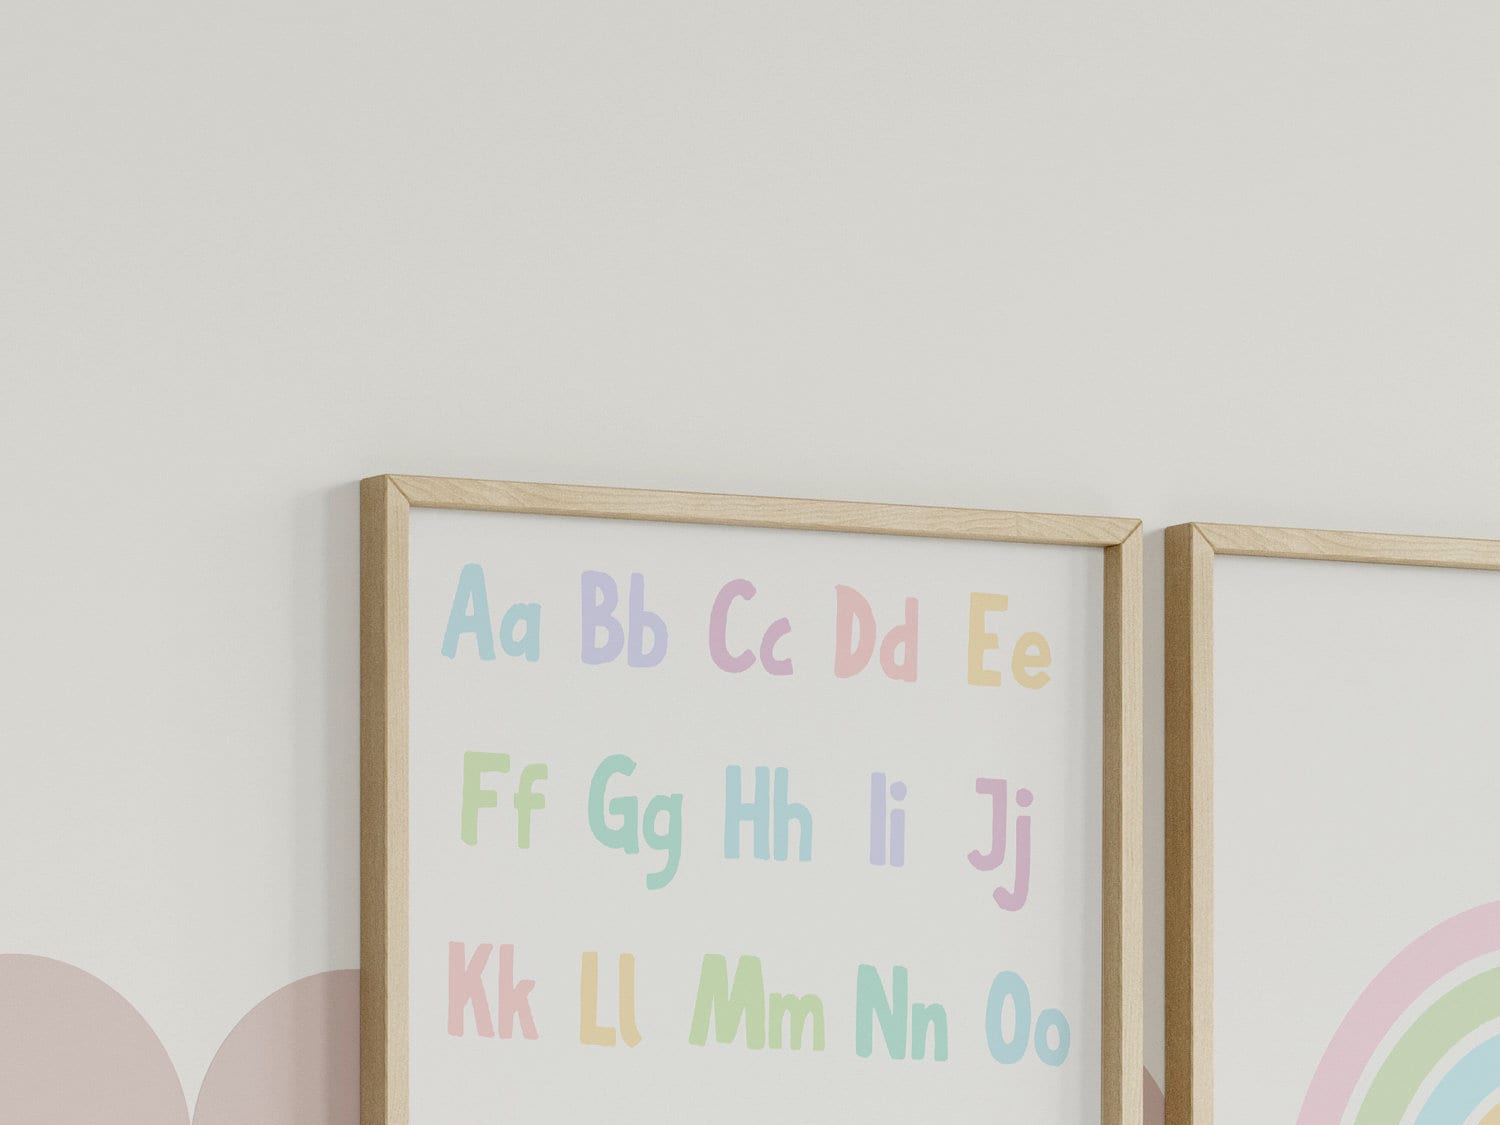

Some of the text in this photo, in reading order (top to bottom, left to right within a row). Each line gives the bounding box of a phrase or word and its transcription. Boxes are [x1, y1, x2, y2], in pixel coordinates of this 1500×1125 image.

[441, 564, 1052, 690] Aa Bb Cc Dd Ee
[460, 751, 1035, 912] Ff Gg Hh Ii Jj
[448, 942, 1071, 1067] Kk Ll Mm Nn Oo
